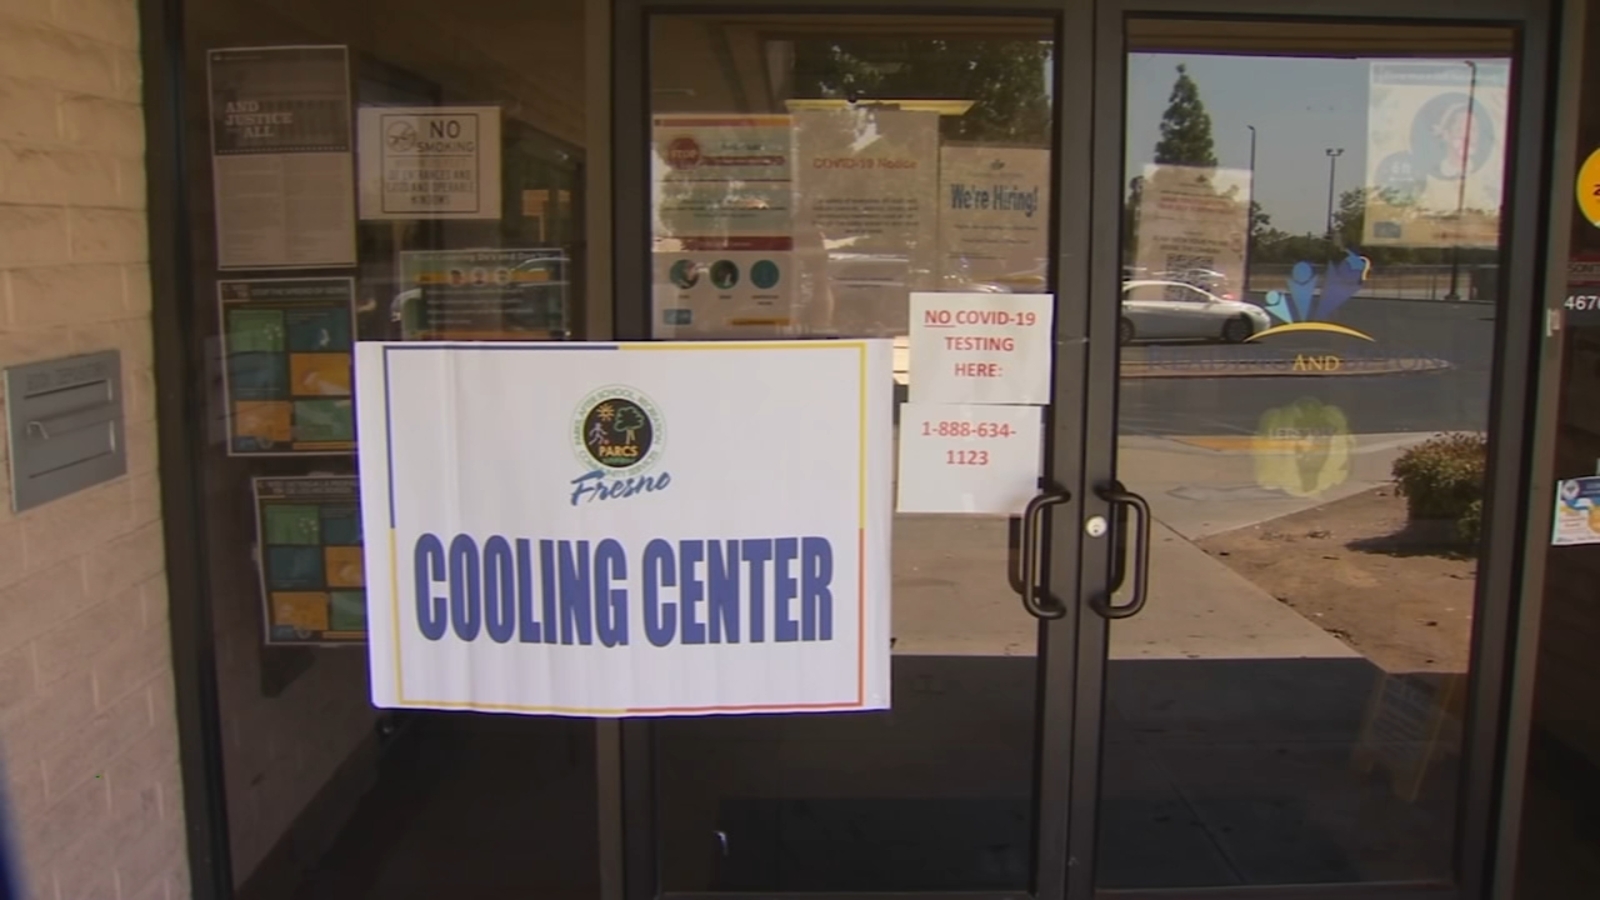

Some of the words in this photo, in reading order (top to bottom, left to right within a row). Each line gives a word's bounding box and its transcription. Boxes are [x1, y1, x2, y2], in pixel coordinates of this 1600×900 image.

[225, 101, 260, 113] AND
[225, 112, 293, 126] JUSTICE
[429, 120, 461, 139] NO
[417, 141, 475, 152] SMOKING
[950, 183, 990, 209] We're
[992, 184, 1039, 217] Hiring!
[1564, 295, 1600, 310] 467
[924, 310, 951, 324] NO
[955, 310, 1036, 326] COVID-19
[945, 337, 1014, 351] TESTING
[1292, 353, 1341, 371] AND
[955, 363, 1003, 377] HERE:
[922, 421, 1017, 437] 1-888-634-
[599, 445, 639, 457] PARCS
[946, 450, 989, 465] 1123
[570, 469, 671, 506] Fresno
[414, 533, 629, 647] COOLING
[641, 537, 833, 647] CENTER
